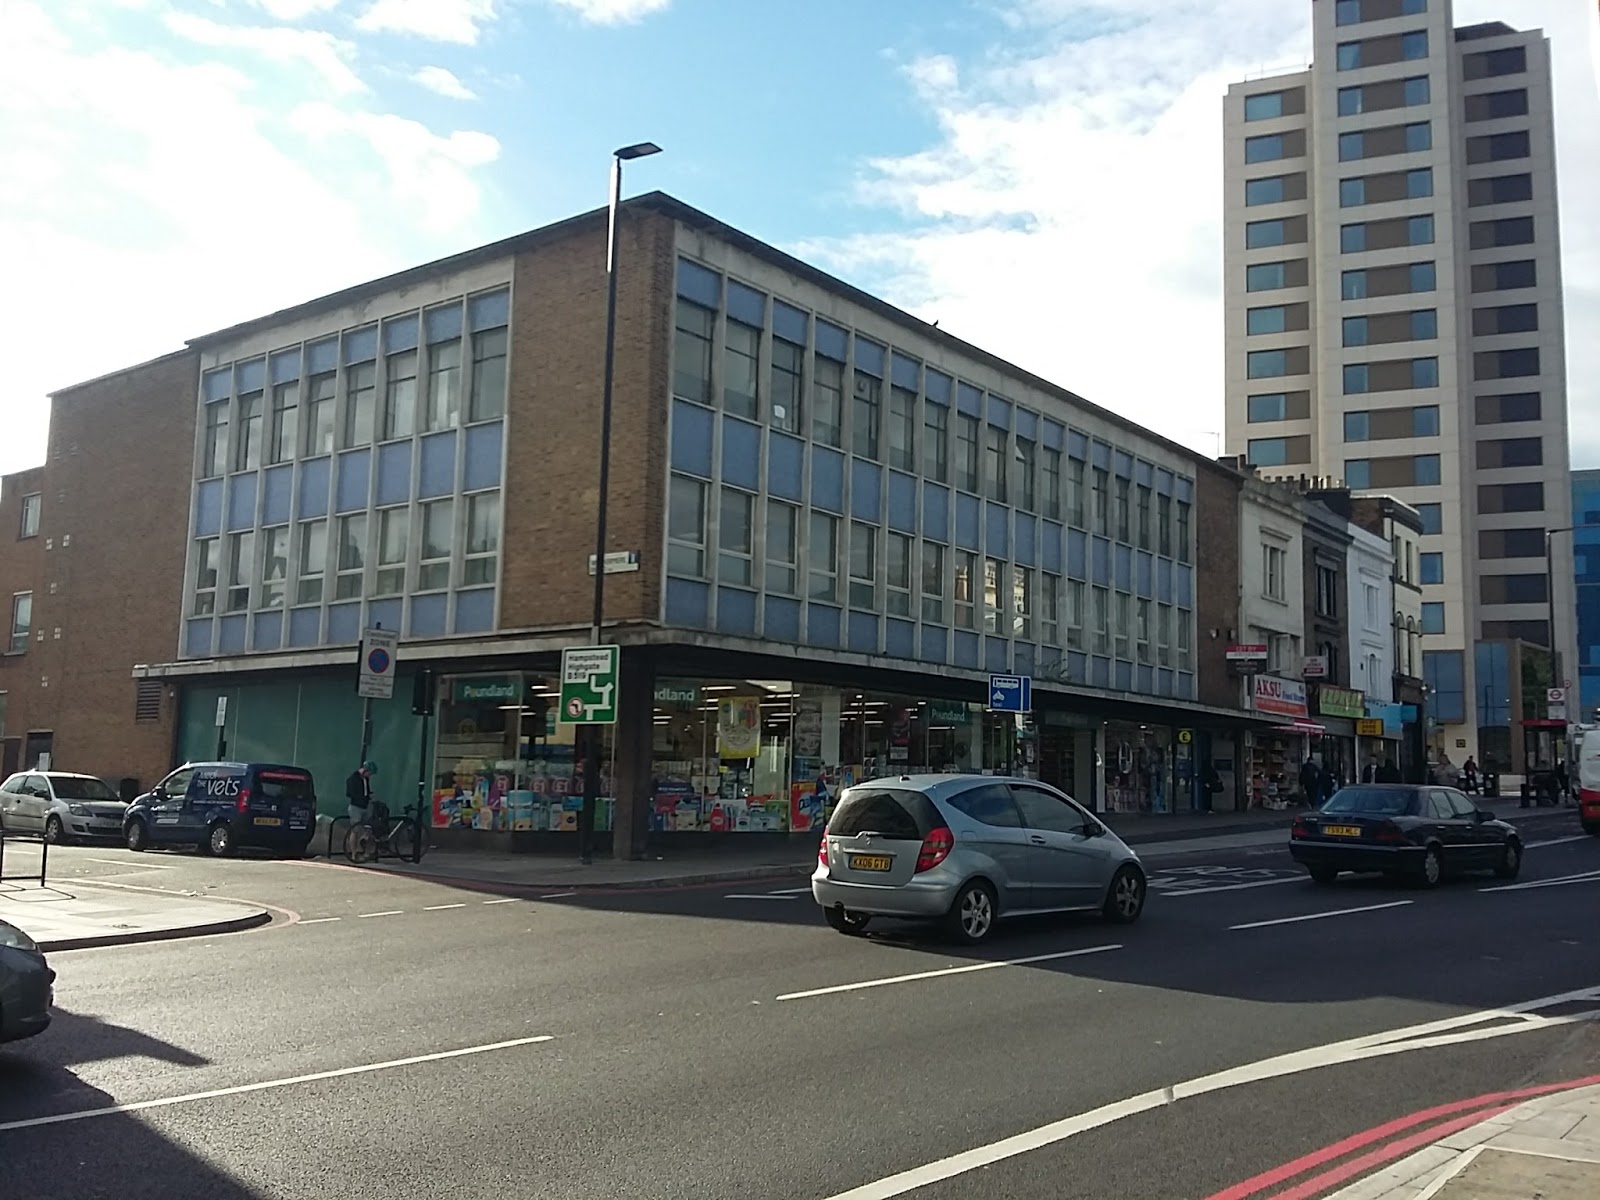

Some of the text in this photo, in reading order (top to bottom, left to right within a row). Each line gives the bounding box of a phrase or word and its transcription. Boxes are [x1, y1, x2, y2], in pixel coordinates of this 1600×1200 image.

[568, 653, 609, 662] Hampstead
[568, 663, 600, 672] Highgate
[464, 684, 514, 697] Poundland
[1256, 678, 1281, 698] AKSU
[207, 776, 241, 796] vets
[853, 857, 873, 868] KX06
